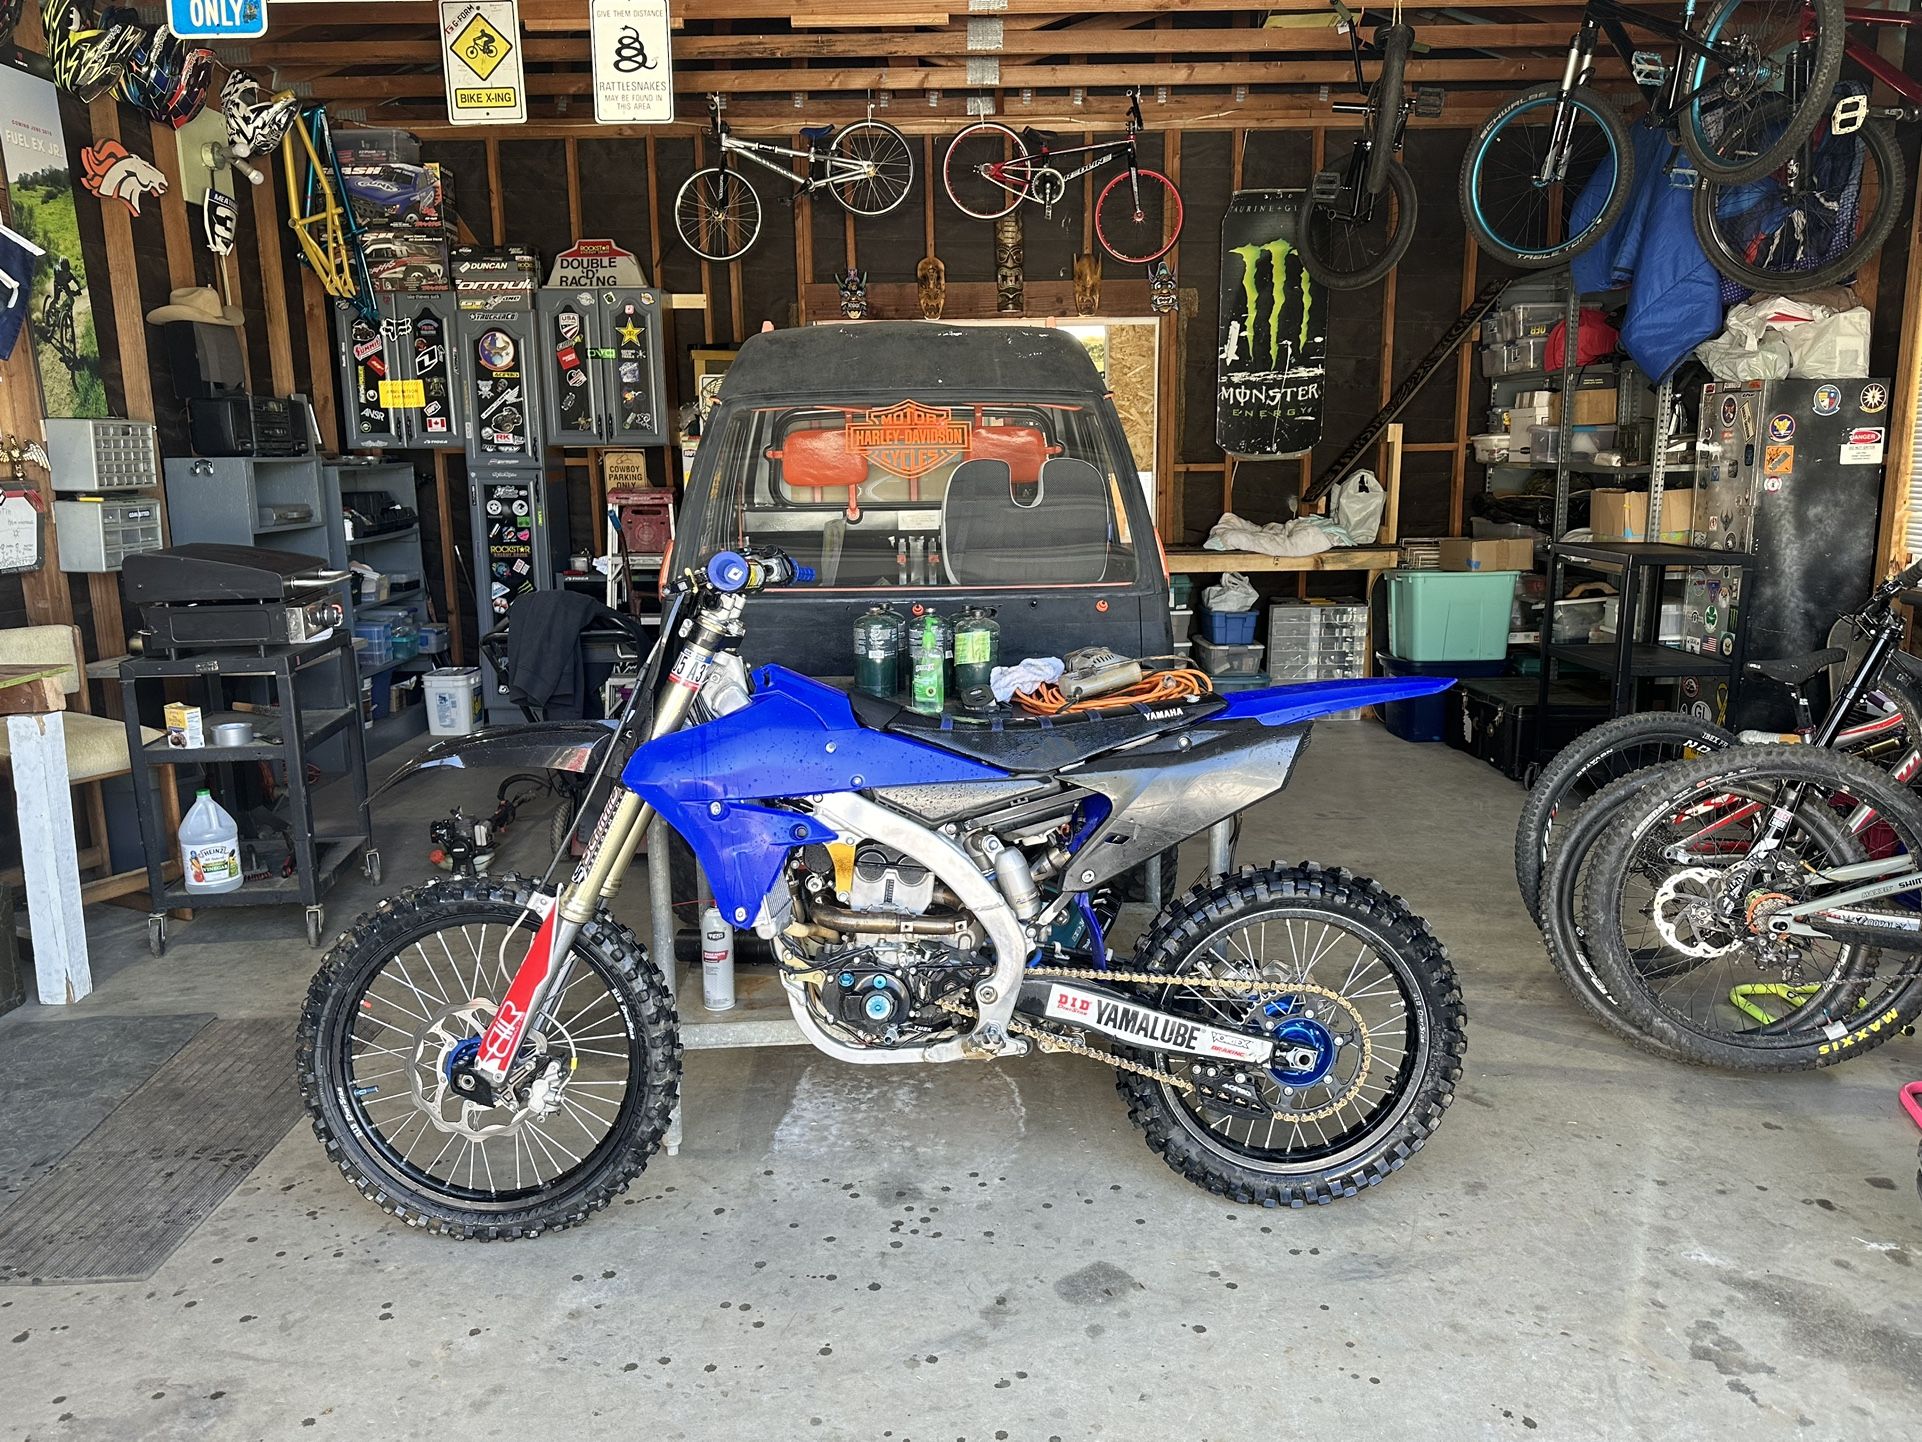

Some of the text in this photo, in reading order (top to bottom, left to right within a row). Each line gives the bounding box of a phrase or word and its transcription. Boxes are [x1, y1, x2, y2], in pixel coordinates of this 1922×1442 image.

[190, 0, 243, 27] ONLY
[452, 4, 475, 28] G-FORM
[596, 10, 663, 18] GIVE THEM DISTANCE
[599, 81, 667, 92] RATTLESNAKES
[460, 92, 512, 104] BIKE X-ING
[604, 94, 663, 102] MAY BE FOUND IN
[5, 129, 63, 158] FUEL EX JR.
[1230, 205, 1275, 213] TAURINE
[470, 262, 508, 270] DUNCAN
[560, 257, 617, 269] DOUBLE
[560, 275, 617, 287] RACING
[360, 408, 385, 421] ANSR
[880, 407, 937, 425] MOTOR
[1232, 406, 1313, 418] ENERGY
[856, 429, 963, 446] HARLEY-DAVIDSON
[881, 449, 939, 472] CYCLES
[609, 465, 640, 473] COWBOY
[608, 473, 643, 481] PARKING
[490, 545, 531, 553] ROCKSTAR
[1143, 706, 1184, 721] YAMAHA
[1701, 731, 1720, 744] IBEX
[203, 848, 224, 856] HEINZ
[203, 863, 228, 873] VINEGAR
[1095, 999, 1201, 1050] YAMALUBE
[1818, 1007, 1899, 1055] MAXXIS
